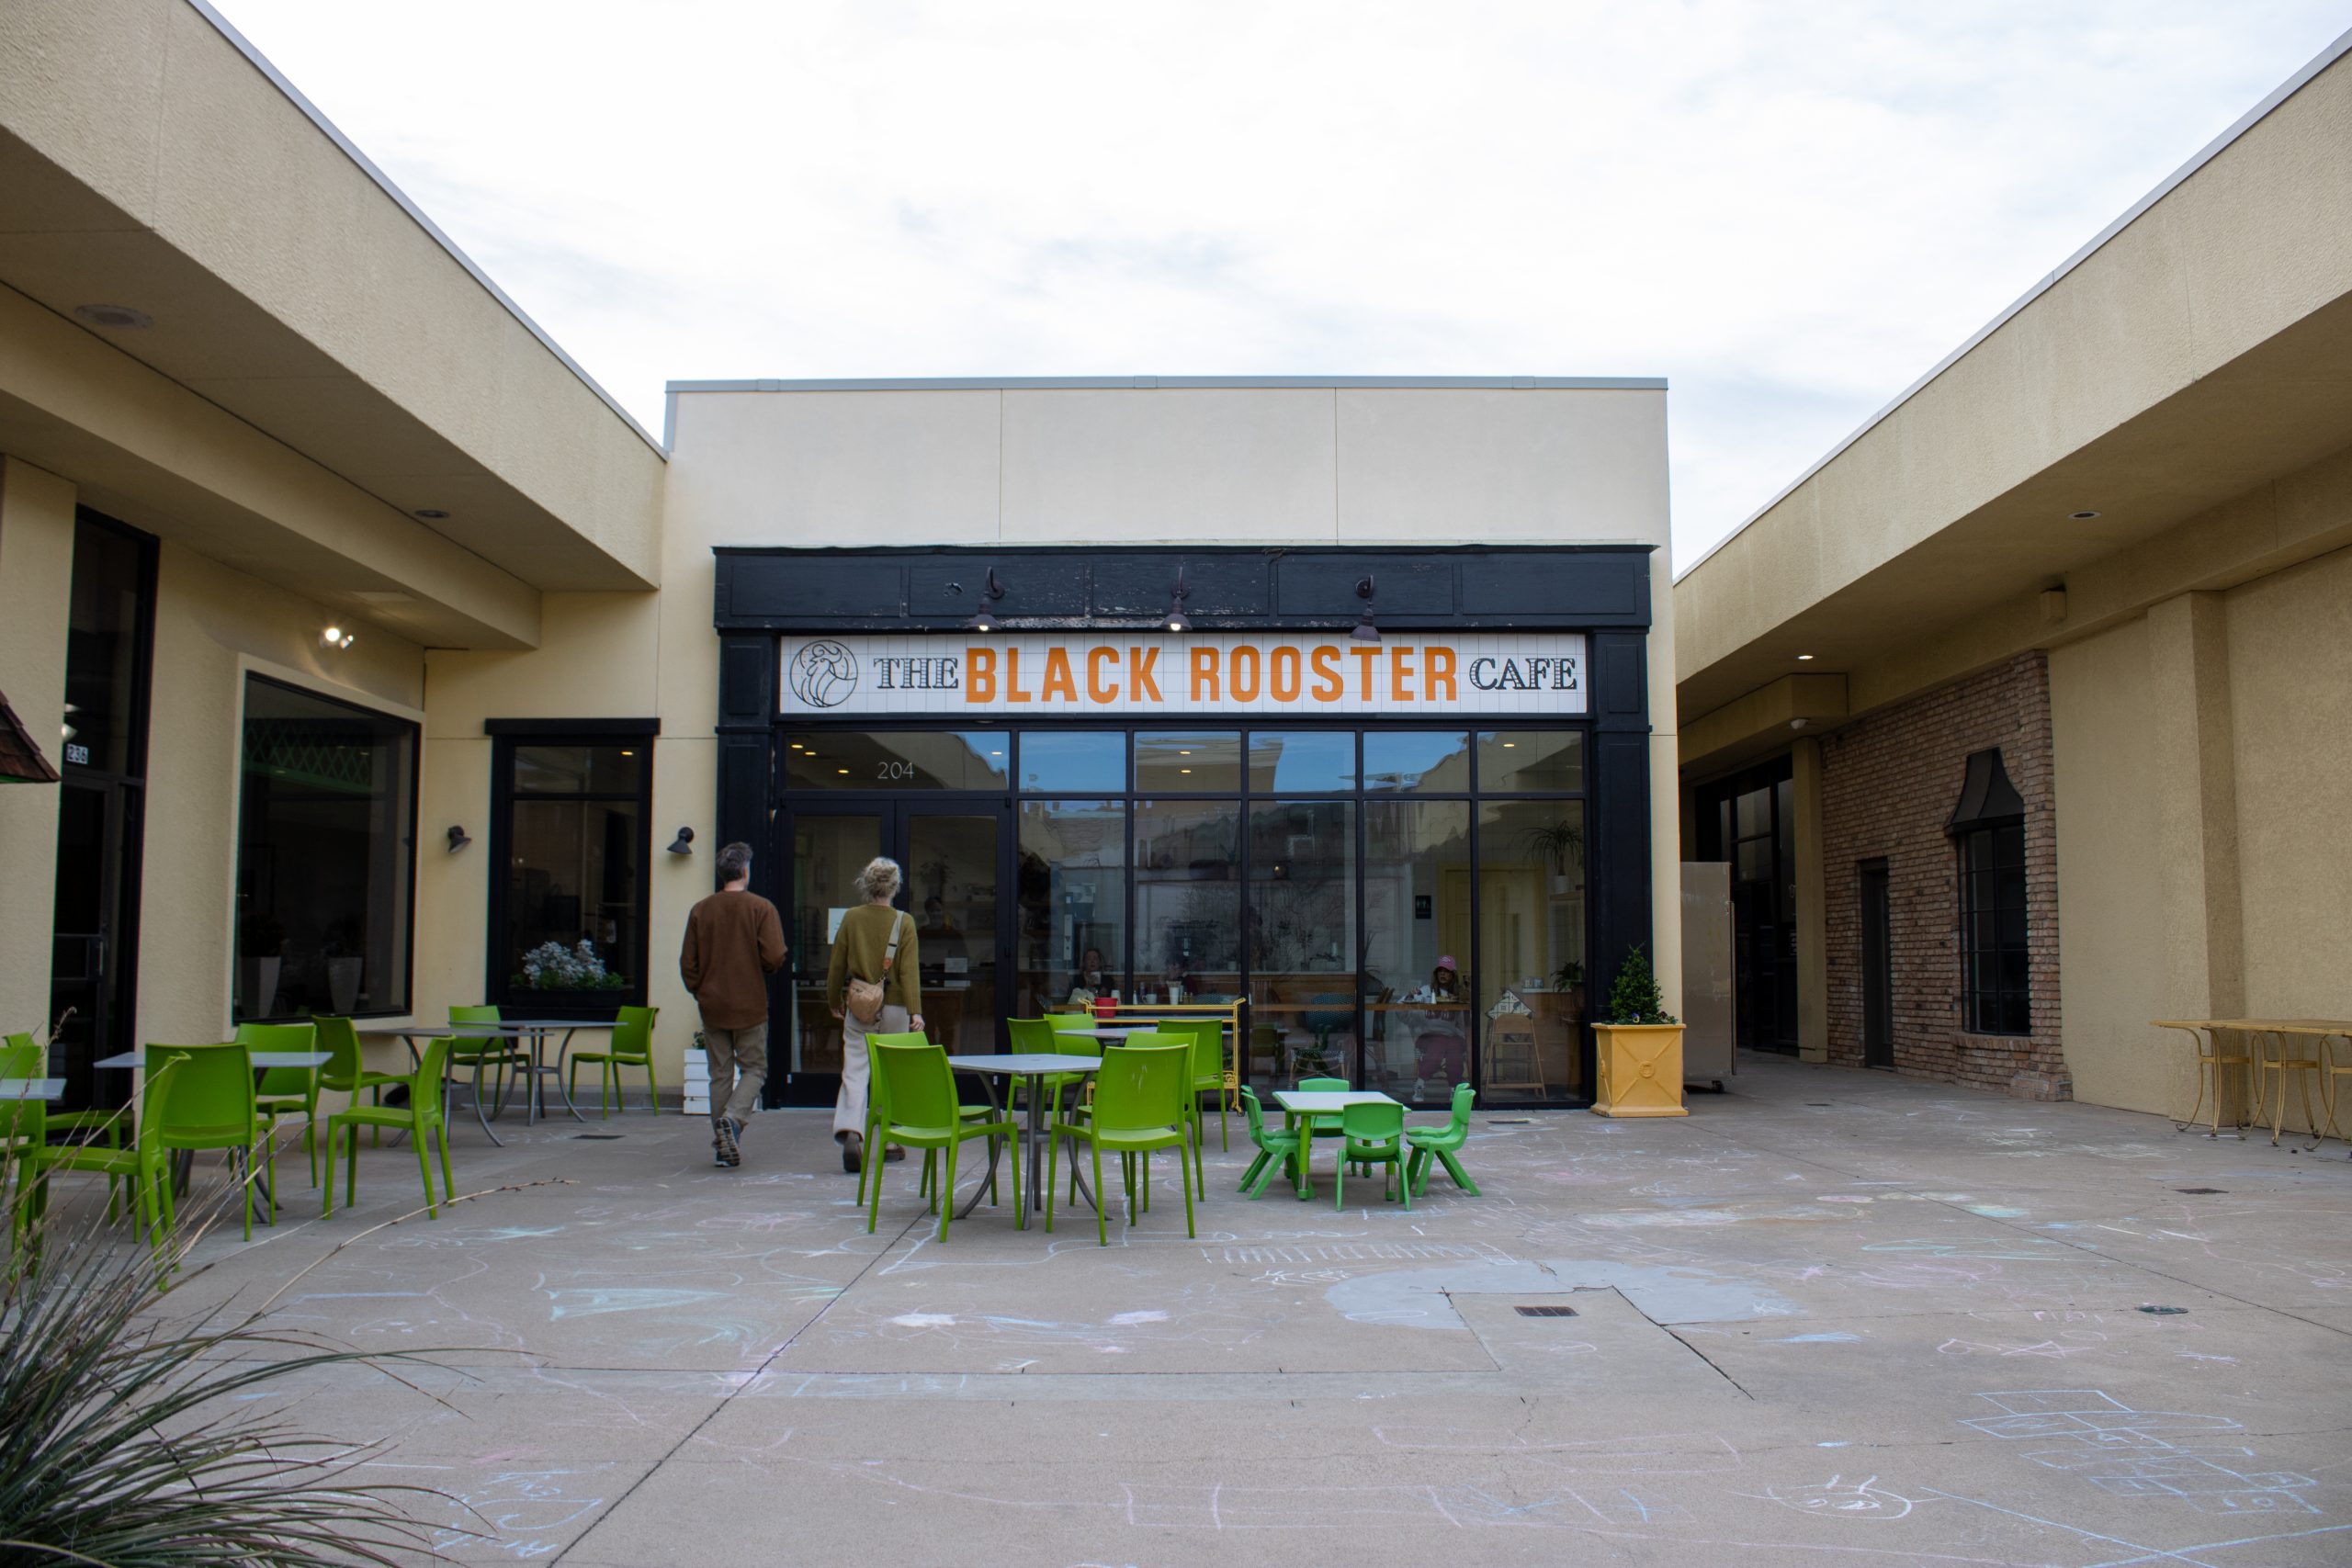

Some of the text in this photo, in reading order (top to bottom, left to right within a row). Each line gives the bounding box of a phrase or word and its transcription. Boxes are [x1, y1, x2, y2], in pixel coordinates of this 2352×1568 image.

[872, 645, 1577, 704] THE BLACK ROOSTER CAFE
[877, 761, 914, 780] 204
